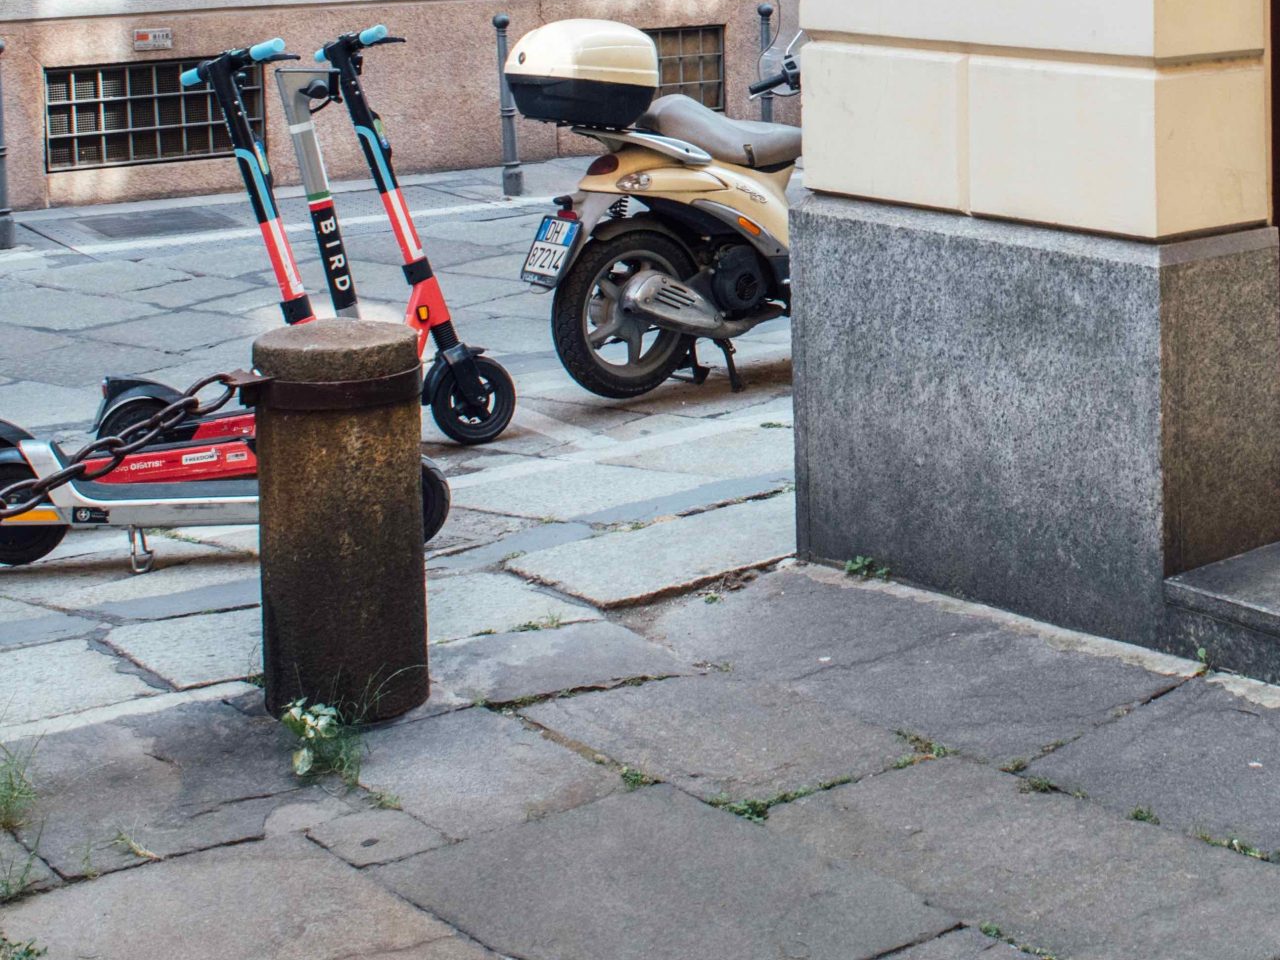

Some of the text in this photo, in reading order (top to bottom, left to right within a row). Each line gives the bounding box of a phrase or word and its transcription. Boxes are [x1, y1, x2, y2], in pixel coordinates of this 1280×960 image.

[545, 221, 564, 242] DH
[320, 216, 350, 291] BIRD
[528, 247, 566, 271] 87214
